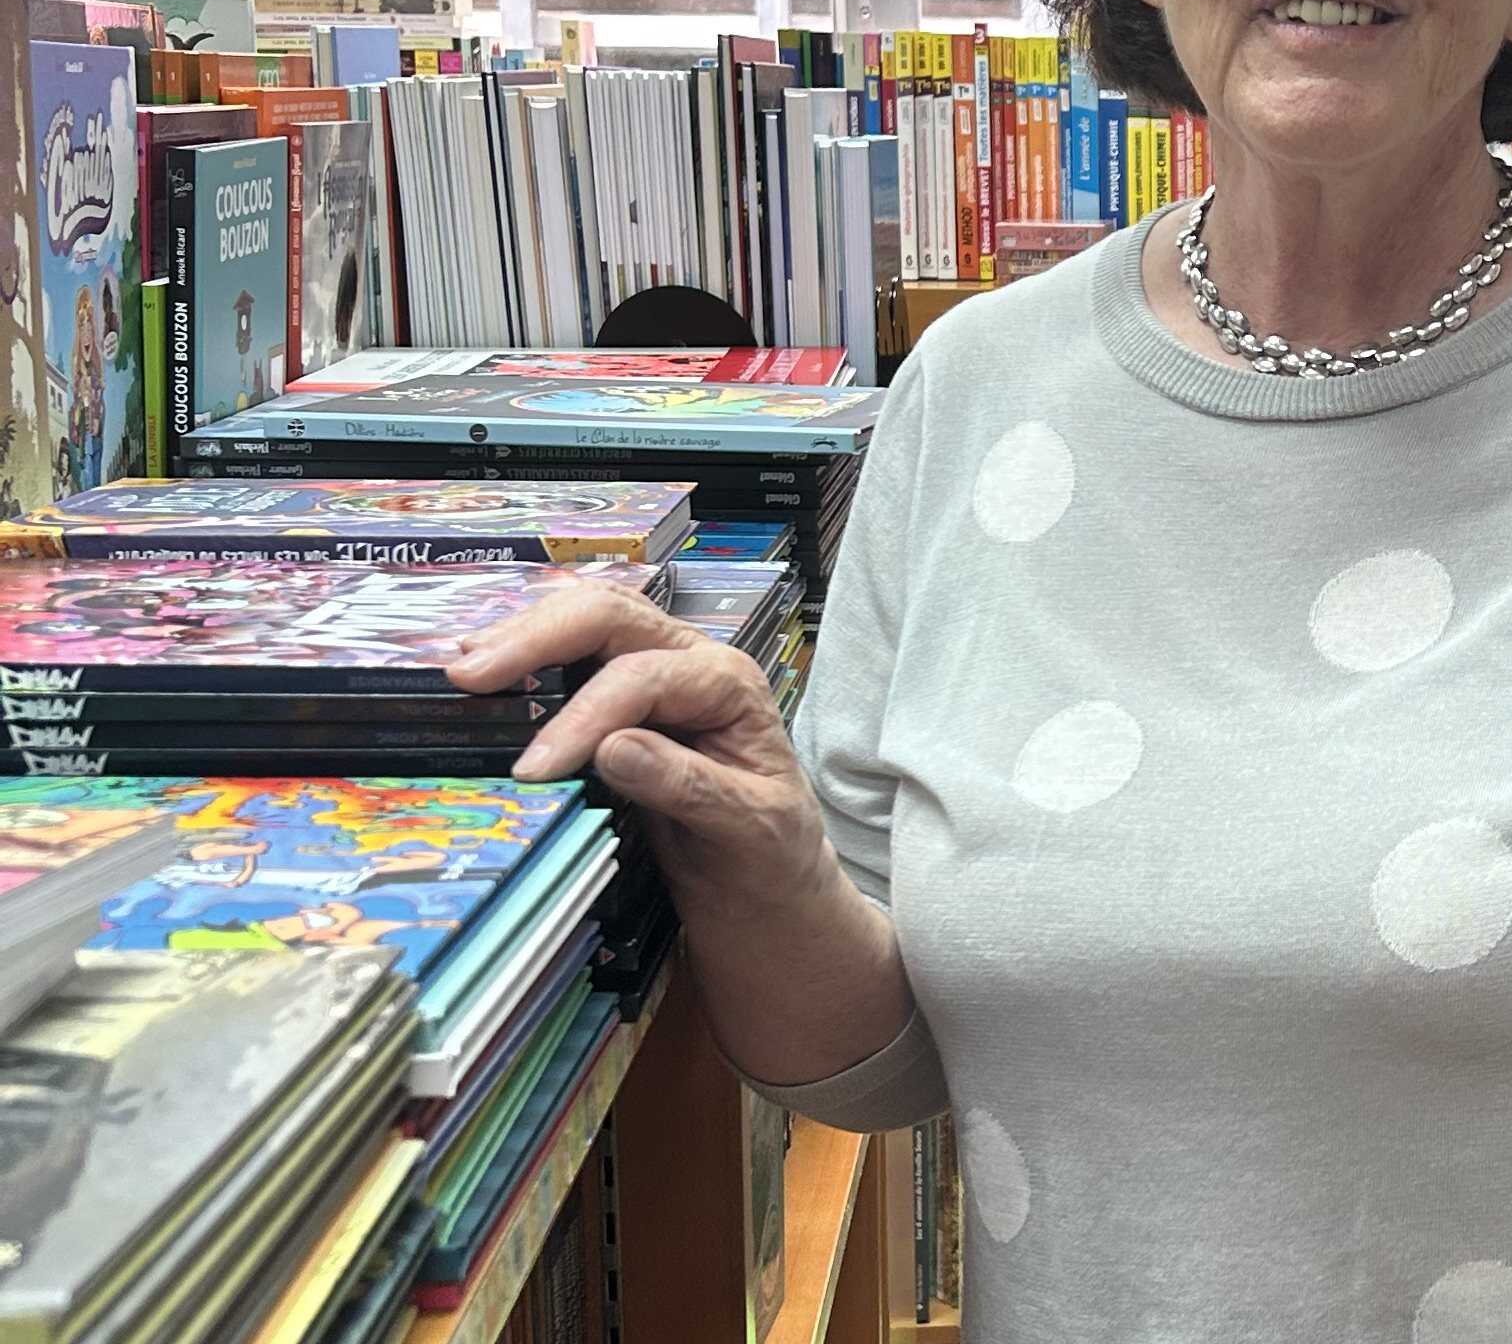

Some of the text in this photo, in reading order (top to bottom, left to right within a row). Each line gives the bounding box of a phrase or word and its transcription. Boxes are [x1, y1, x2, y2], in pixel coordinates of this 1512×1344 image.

[1109, 119, 1121, 212] PHYSIQUE-CHIMIE
[215, 177, 273, 222] COUCOUS
[175, 227, 186, 286] Anouk Ricard
[219, 221, 270, 263] BOUZON
[174, 301, 189, 434] COUCOUS BOUZON
[591, 427, 618, 445] Clan
